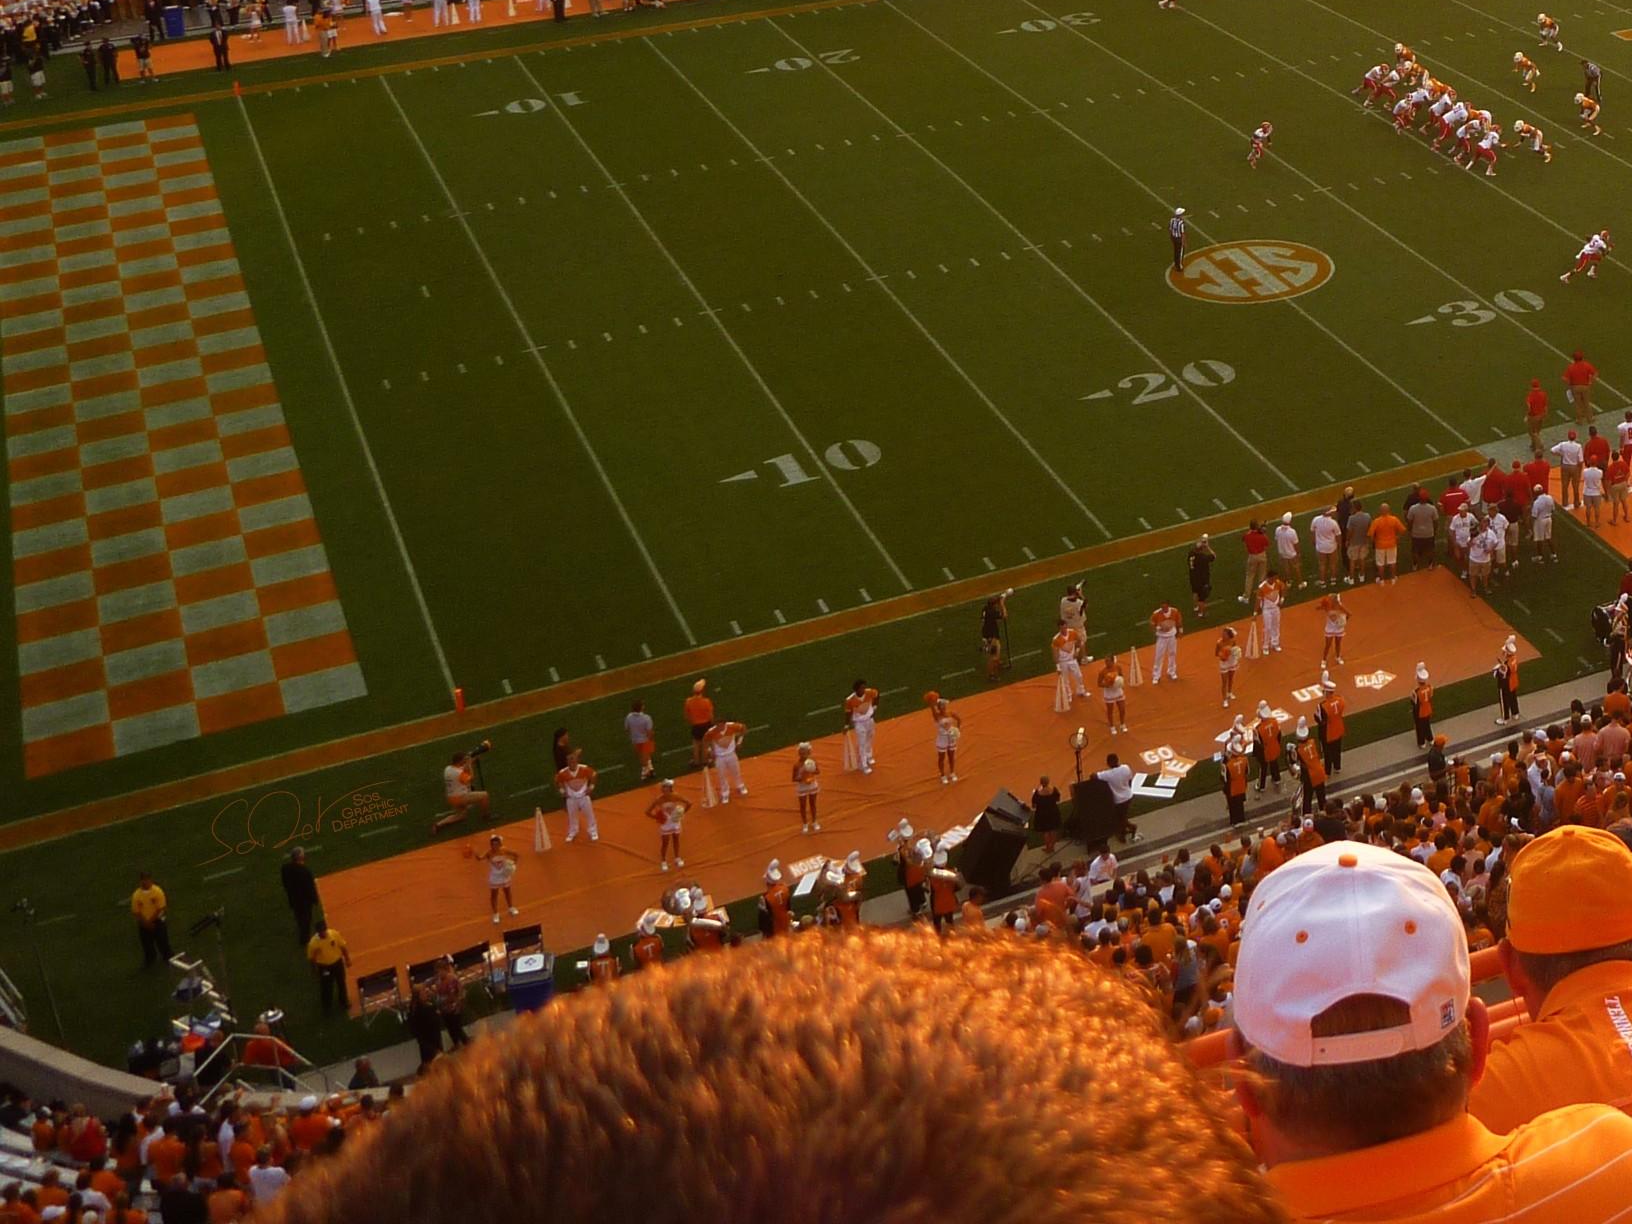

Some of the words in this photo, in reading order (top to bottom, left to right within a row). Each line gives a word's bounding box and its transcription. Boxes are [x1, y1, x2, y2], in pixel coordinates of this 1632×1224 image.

[1438, 288, 1546, 328] 30
[1116, 359, 1237, 408] 20
[762, 438, 883, 488] 10
[1294, 685, 1322, 701] UT
[1143, 747, 1173, 764] GO
